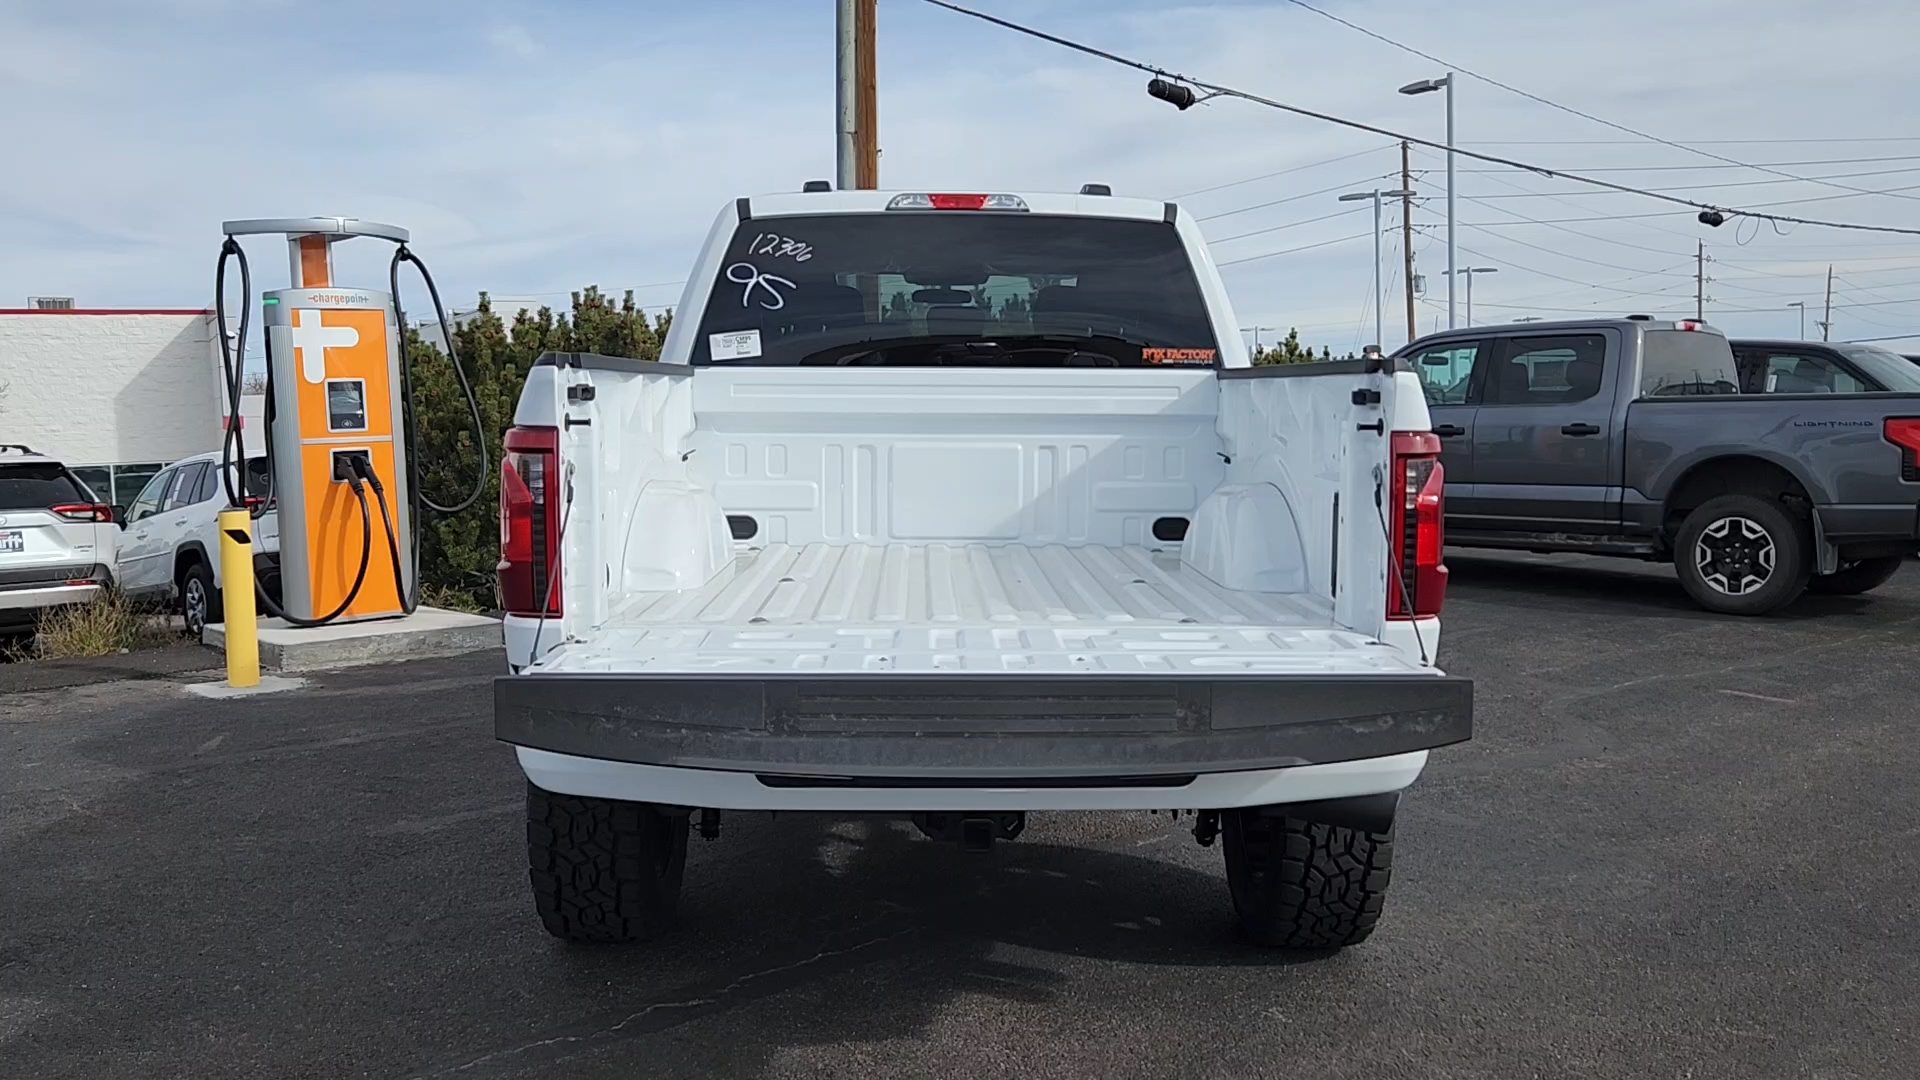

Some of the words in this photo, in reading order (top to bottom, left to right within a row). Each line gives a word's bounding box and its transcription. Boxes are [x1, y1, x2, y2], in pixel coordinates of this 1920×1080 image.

[748, 233, 813, 262] 12306
[726, 262, 797, 310] 95
[1142, 347, 1165, 362] FOX
[1166, 347, 1216, 360] FACTORY
[1794, 421, 1873, 429] LIGHTNING
